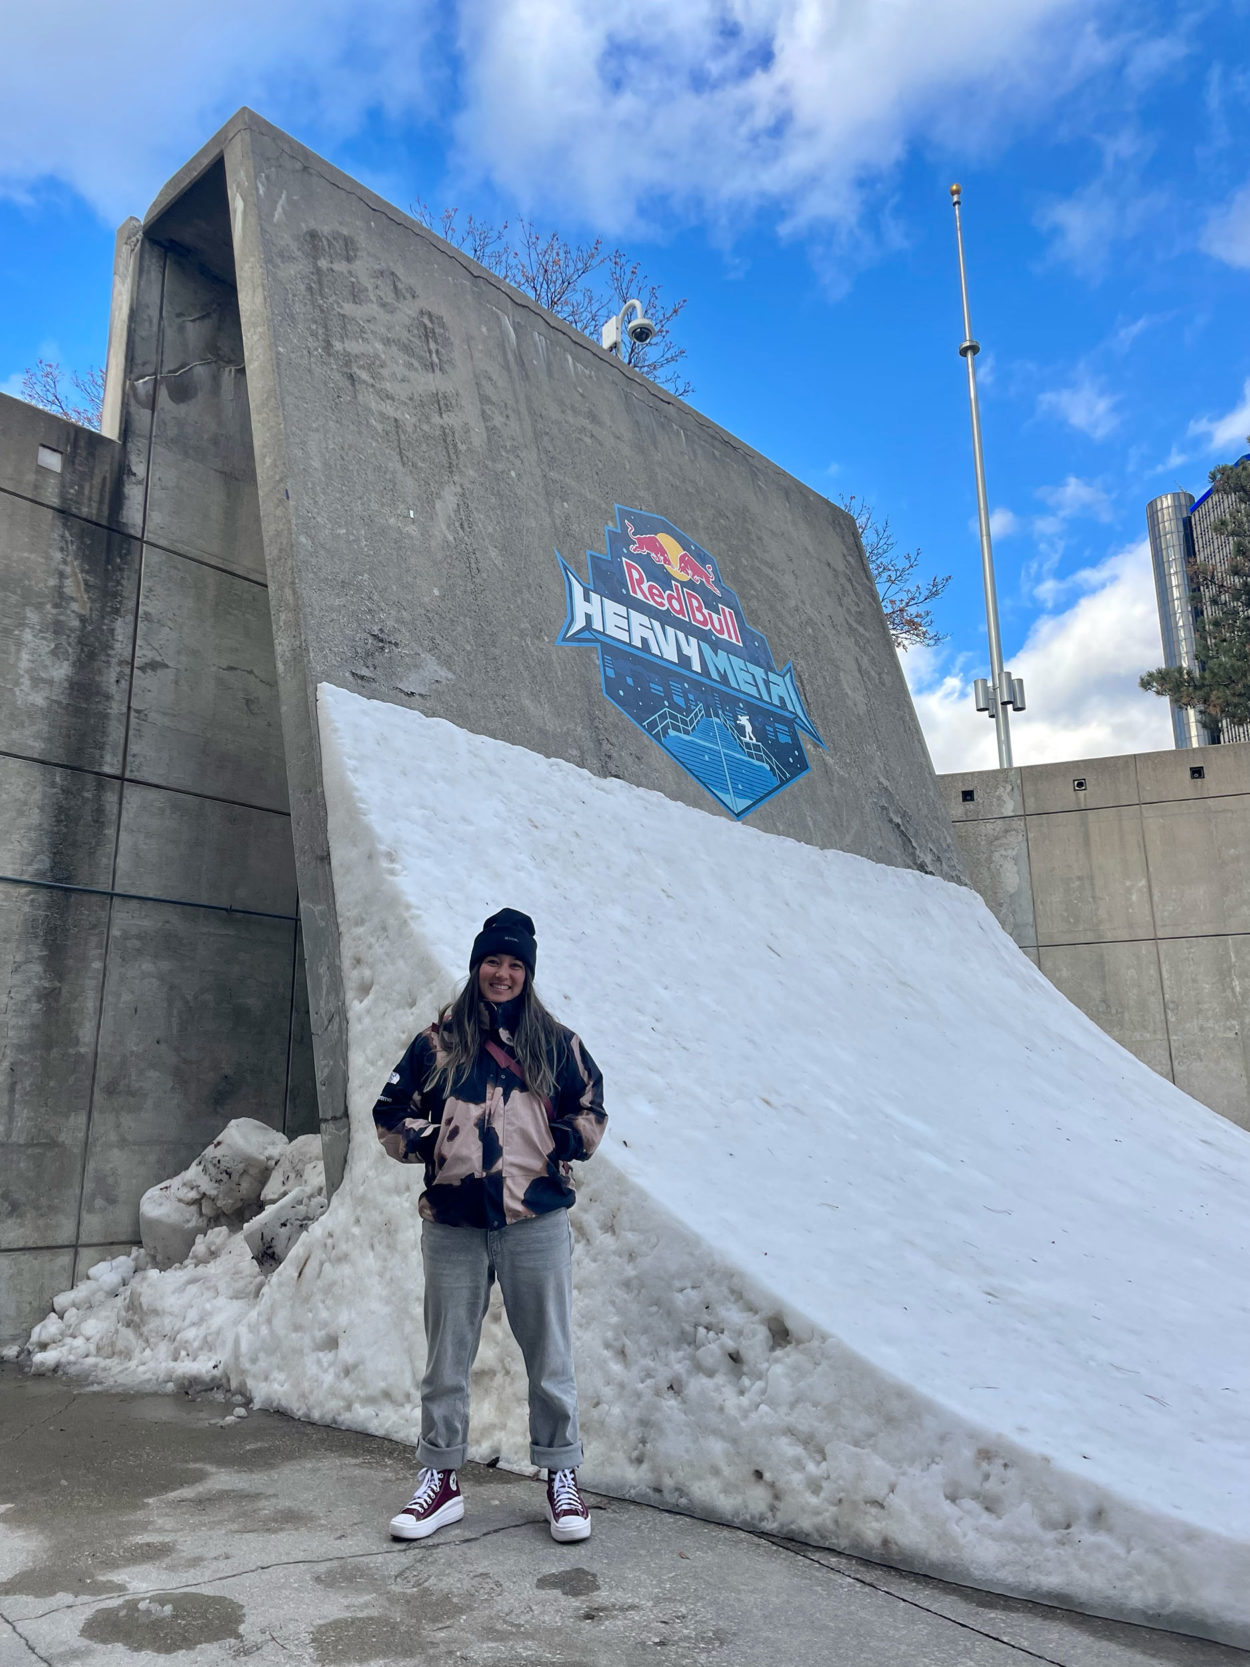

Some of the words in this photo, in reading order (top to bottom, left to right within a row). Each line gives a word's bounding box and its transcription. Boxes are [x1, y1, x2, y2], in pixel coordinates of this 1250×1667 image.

[565, 569, 702, 674] HEAVY
[699, 640, 820, 741] METAL
[622, 557, 689, 622] Red
[683, 588, 743, 647] Bull
